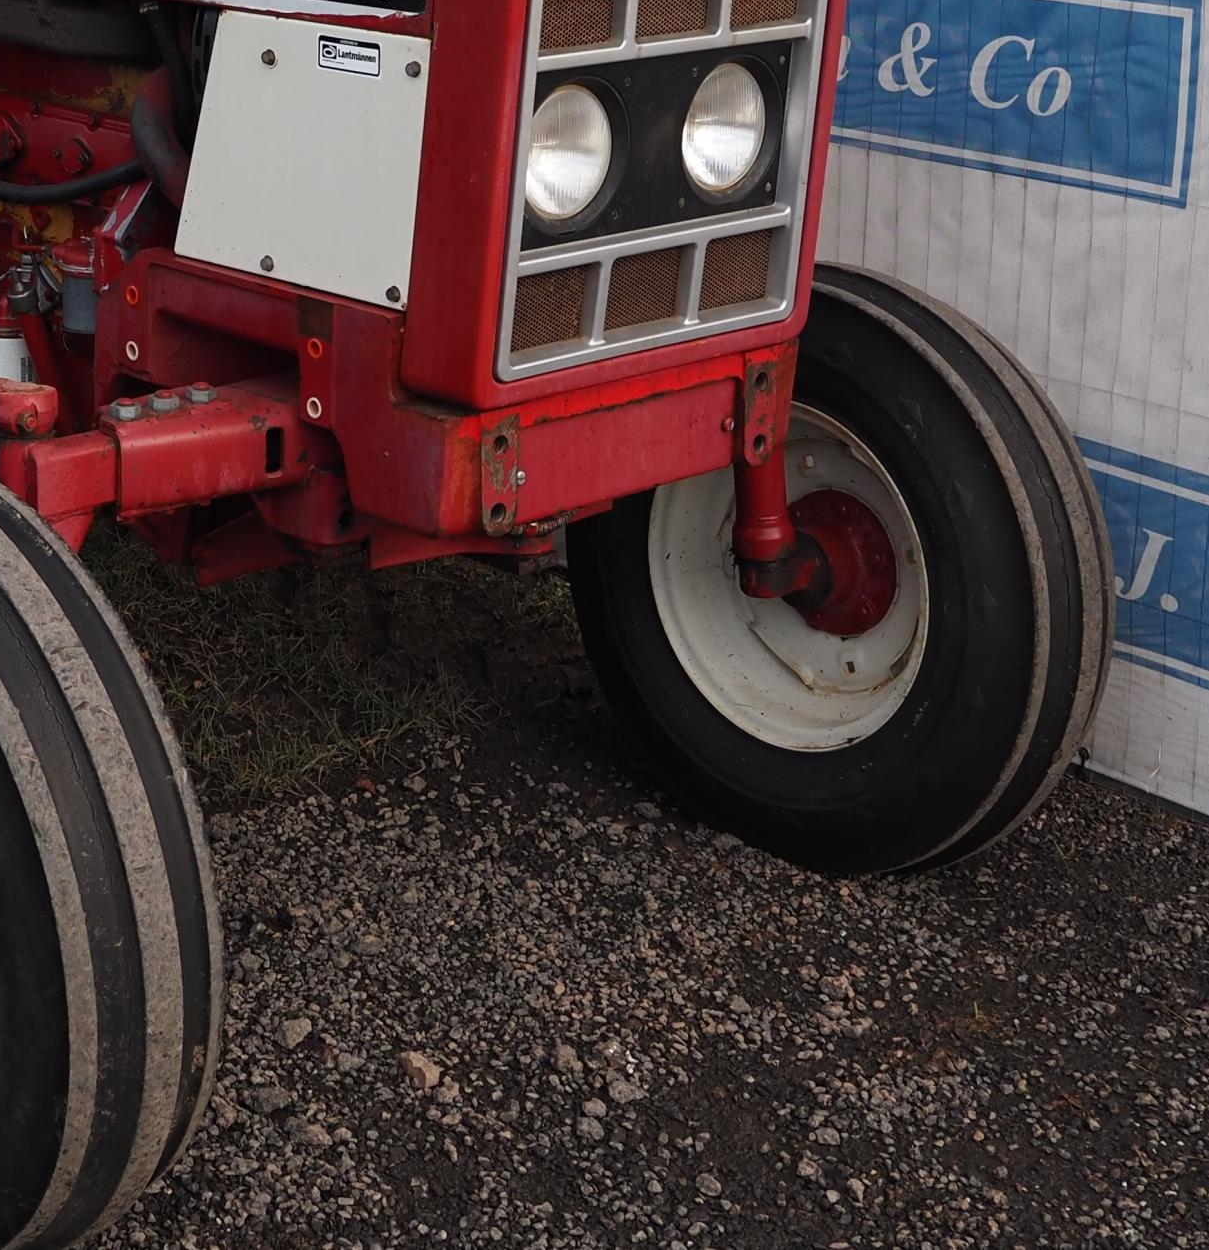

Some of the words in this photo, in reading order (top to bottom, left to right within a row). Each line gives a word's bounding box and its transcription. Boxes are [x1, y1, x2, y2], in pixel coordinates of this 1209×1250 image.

[877, 21, 938, 98] &
[969, 35, 1073, 117] Co
[1114, 527, 1178, 612] J.
